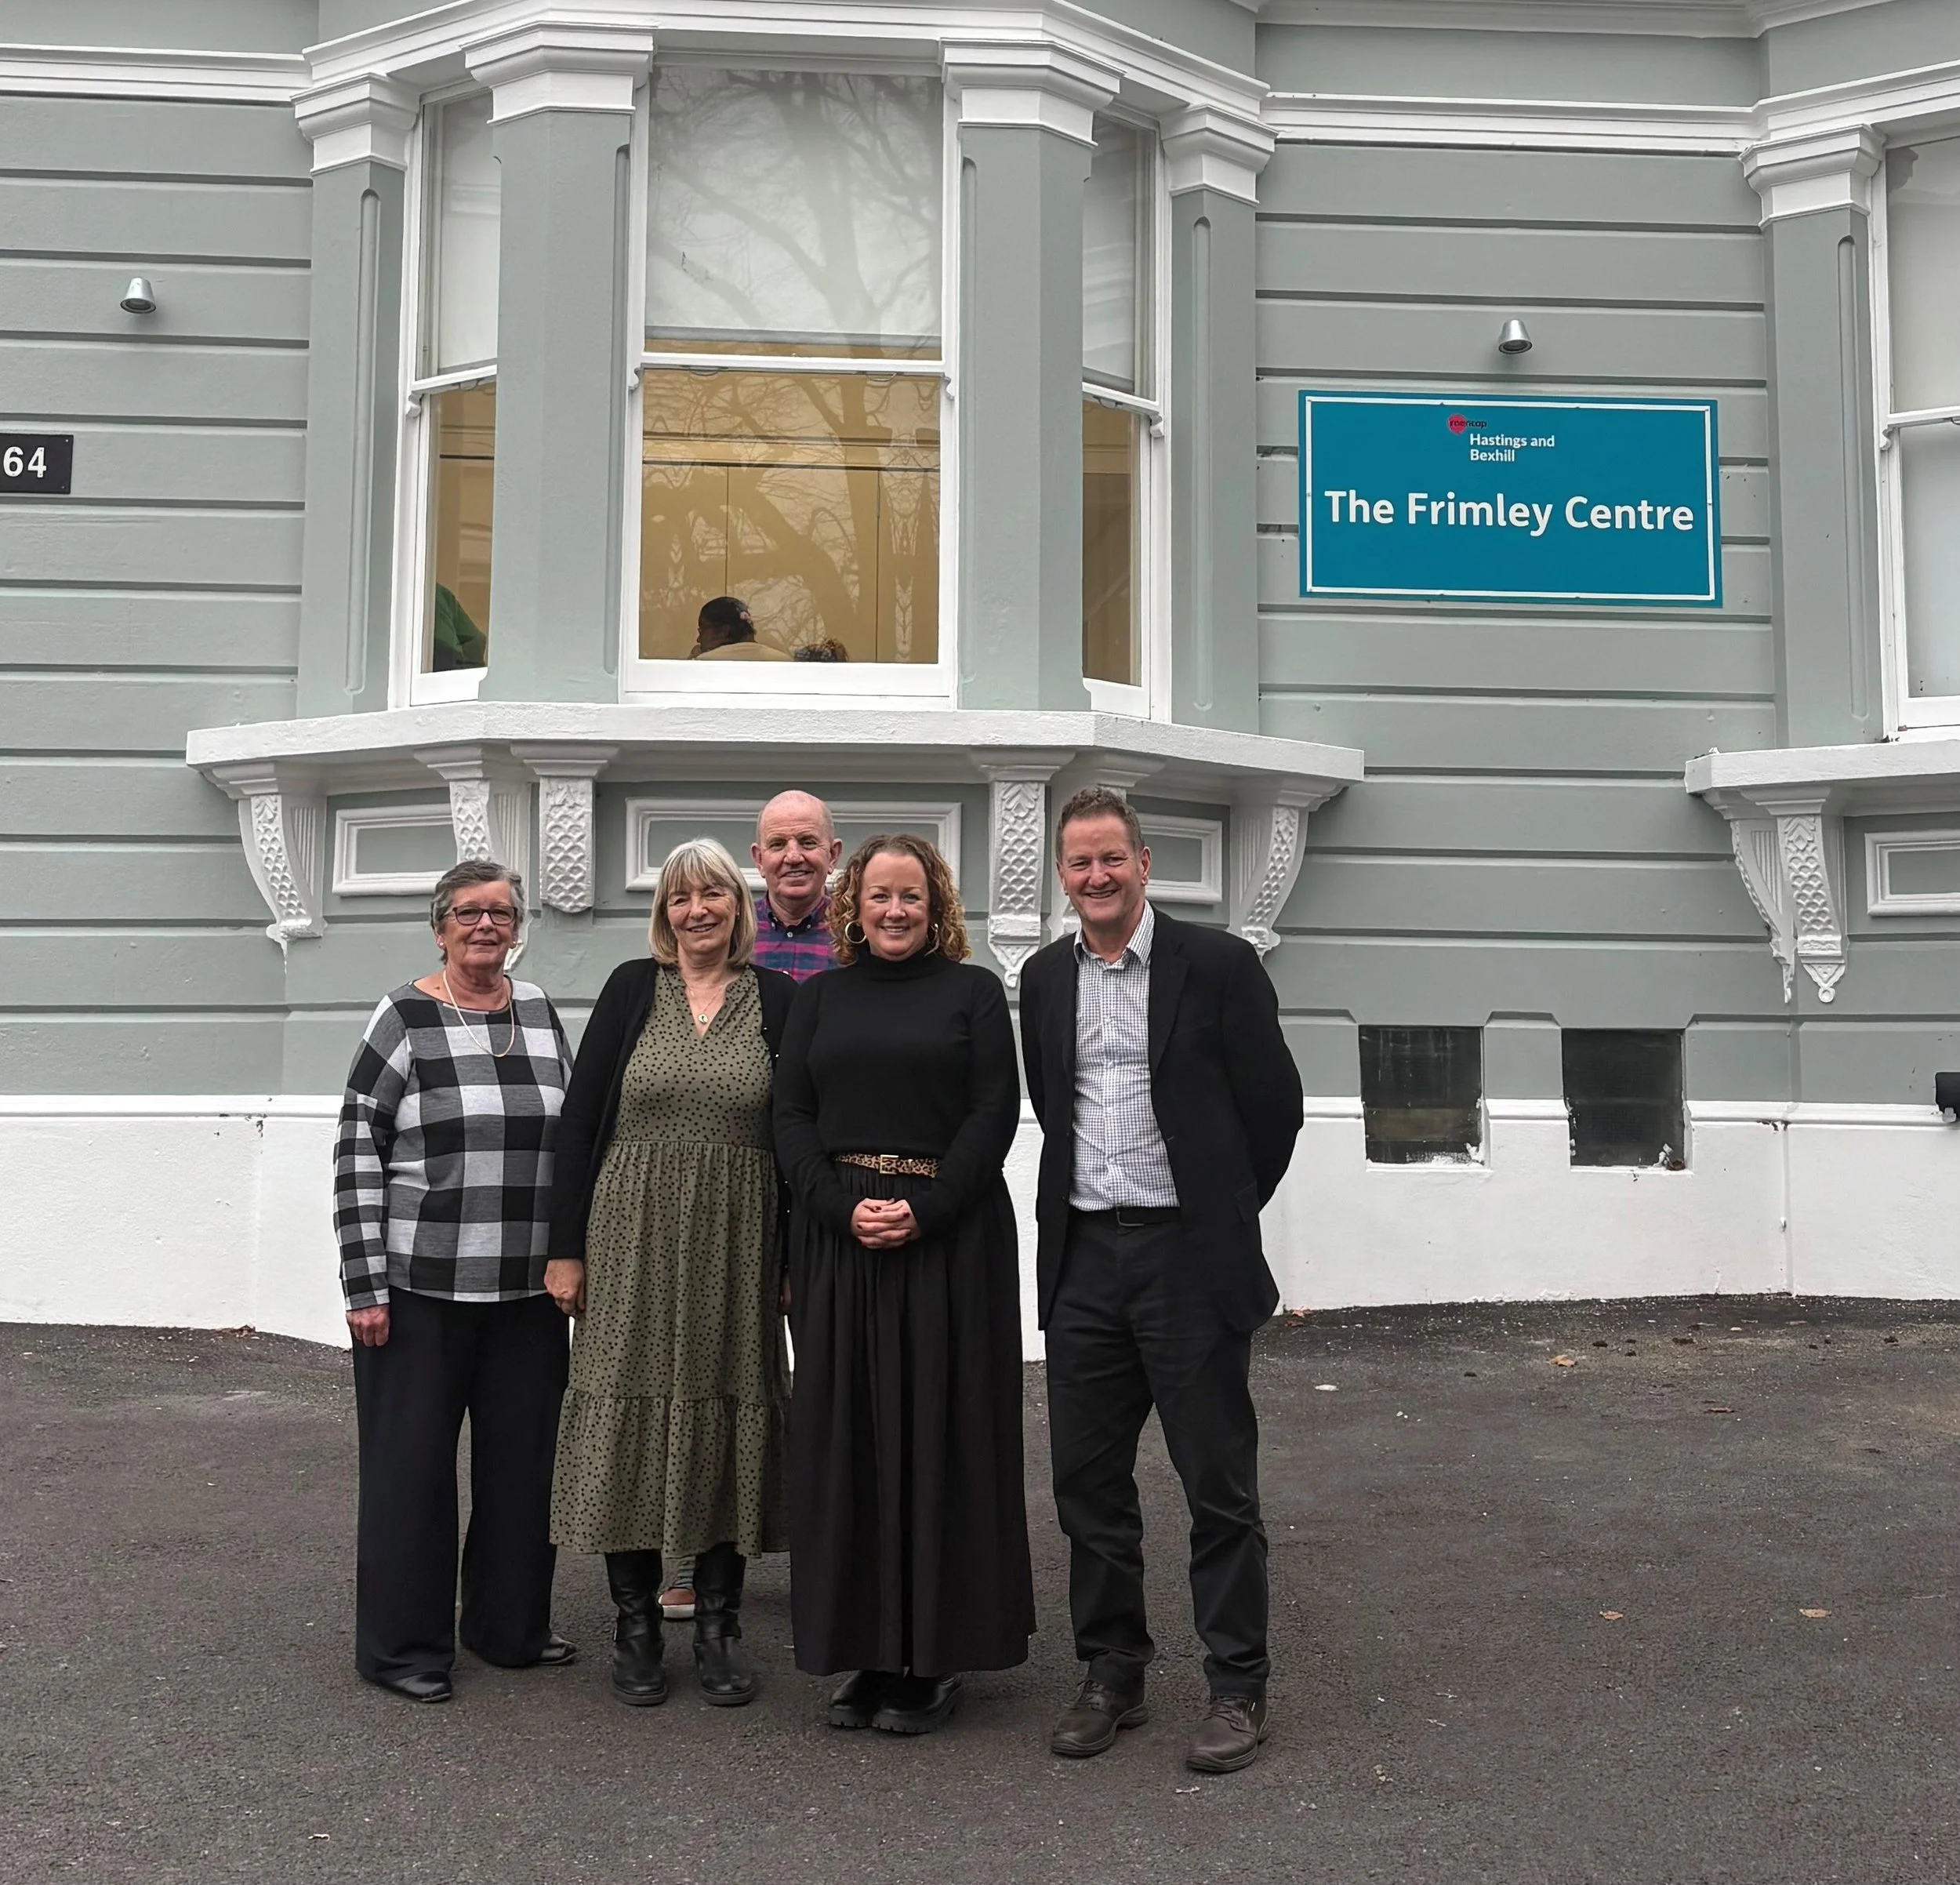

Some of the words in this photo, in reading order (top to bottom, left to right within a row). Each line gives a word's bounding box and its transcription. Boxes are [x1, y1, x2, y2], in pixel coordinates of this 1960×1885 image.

[1470, 434, 1527, 449] Hastings
[1530, 435, 1555, 447] and
[3, 446, 47, 478] 64
[1470, 449, 1515, 462] Bexhill
[1325, 490, 1395, 524] The
[1408, 492, 1553, 536] Frimley
[1565, 496, 1694, 531] Centre
